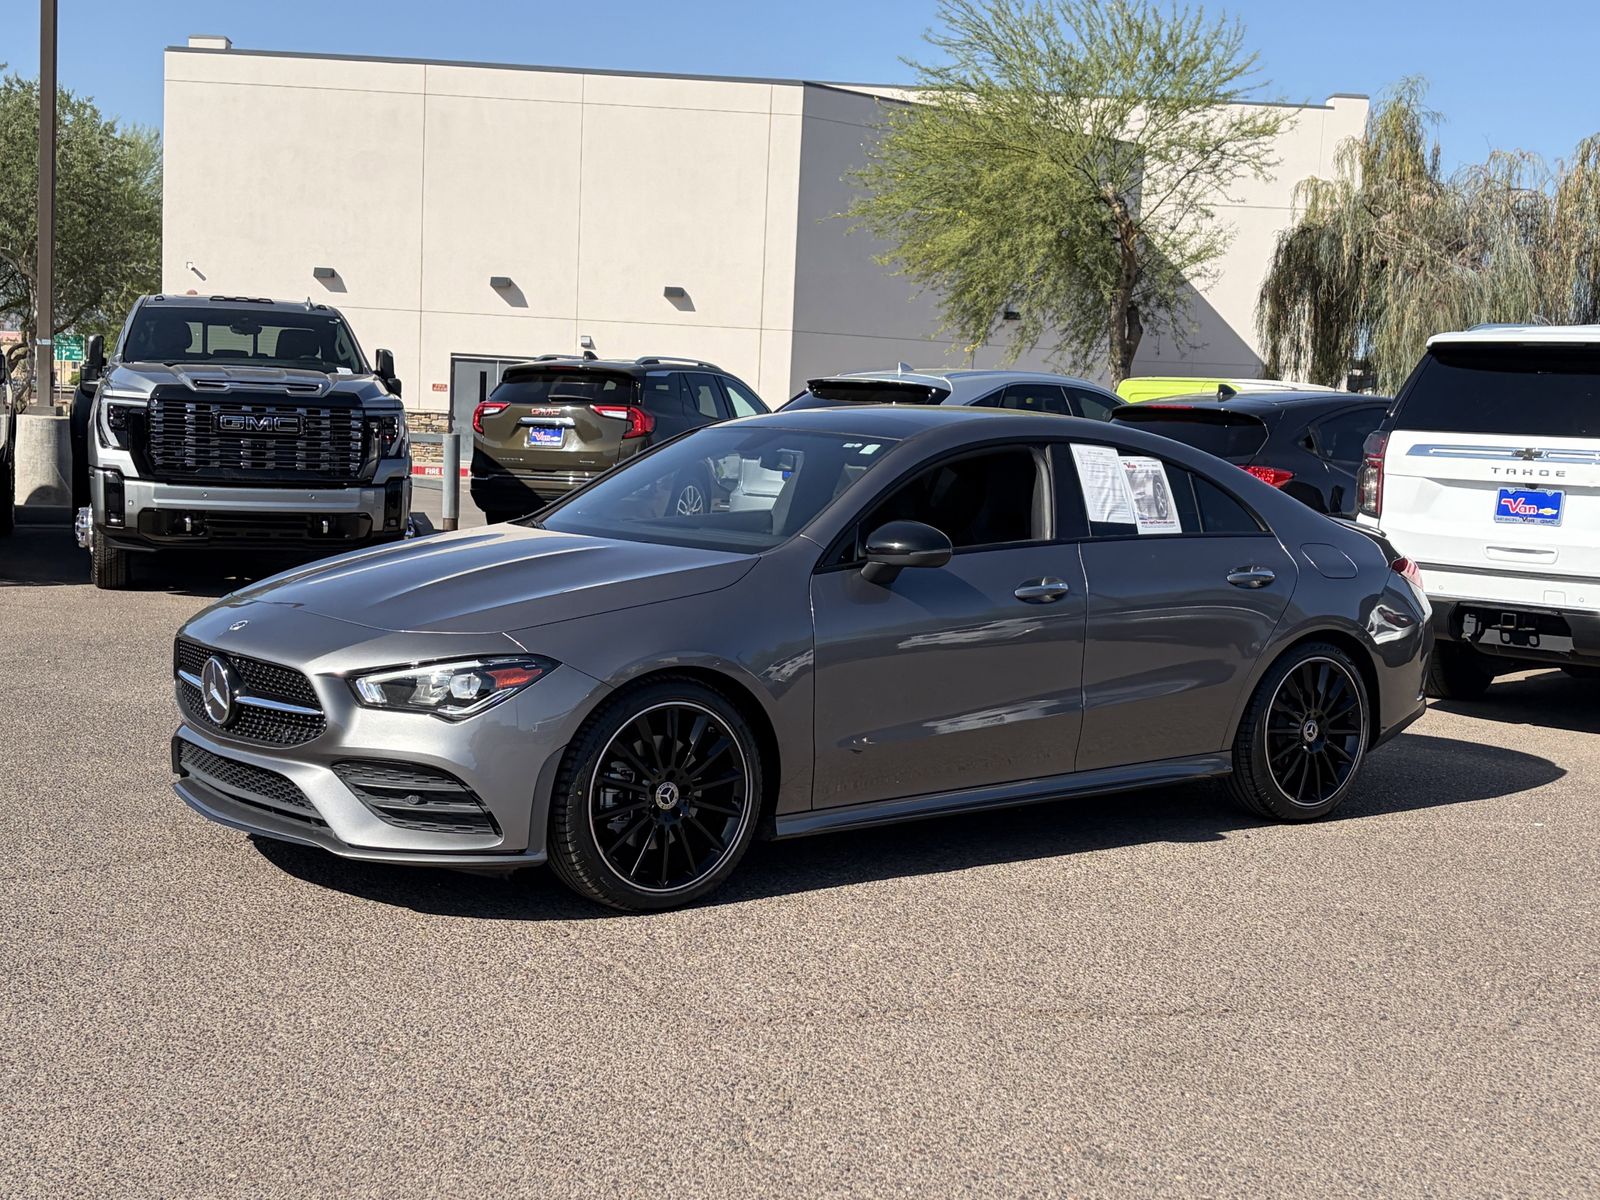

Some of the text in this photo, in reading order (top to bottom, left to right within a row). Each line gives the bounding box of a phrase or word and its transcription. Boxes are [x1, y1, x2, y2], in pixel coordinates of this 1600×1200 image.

[220, 415, 298, 431] GMC
[425, 467, 440, 475] FIRE
[1491, 467, 1566, 477] TAHOE
[1501, 498, 1538, 514] Van
